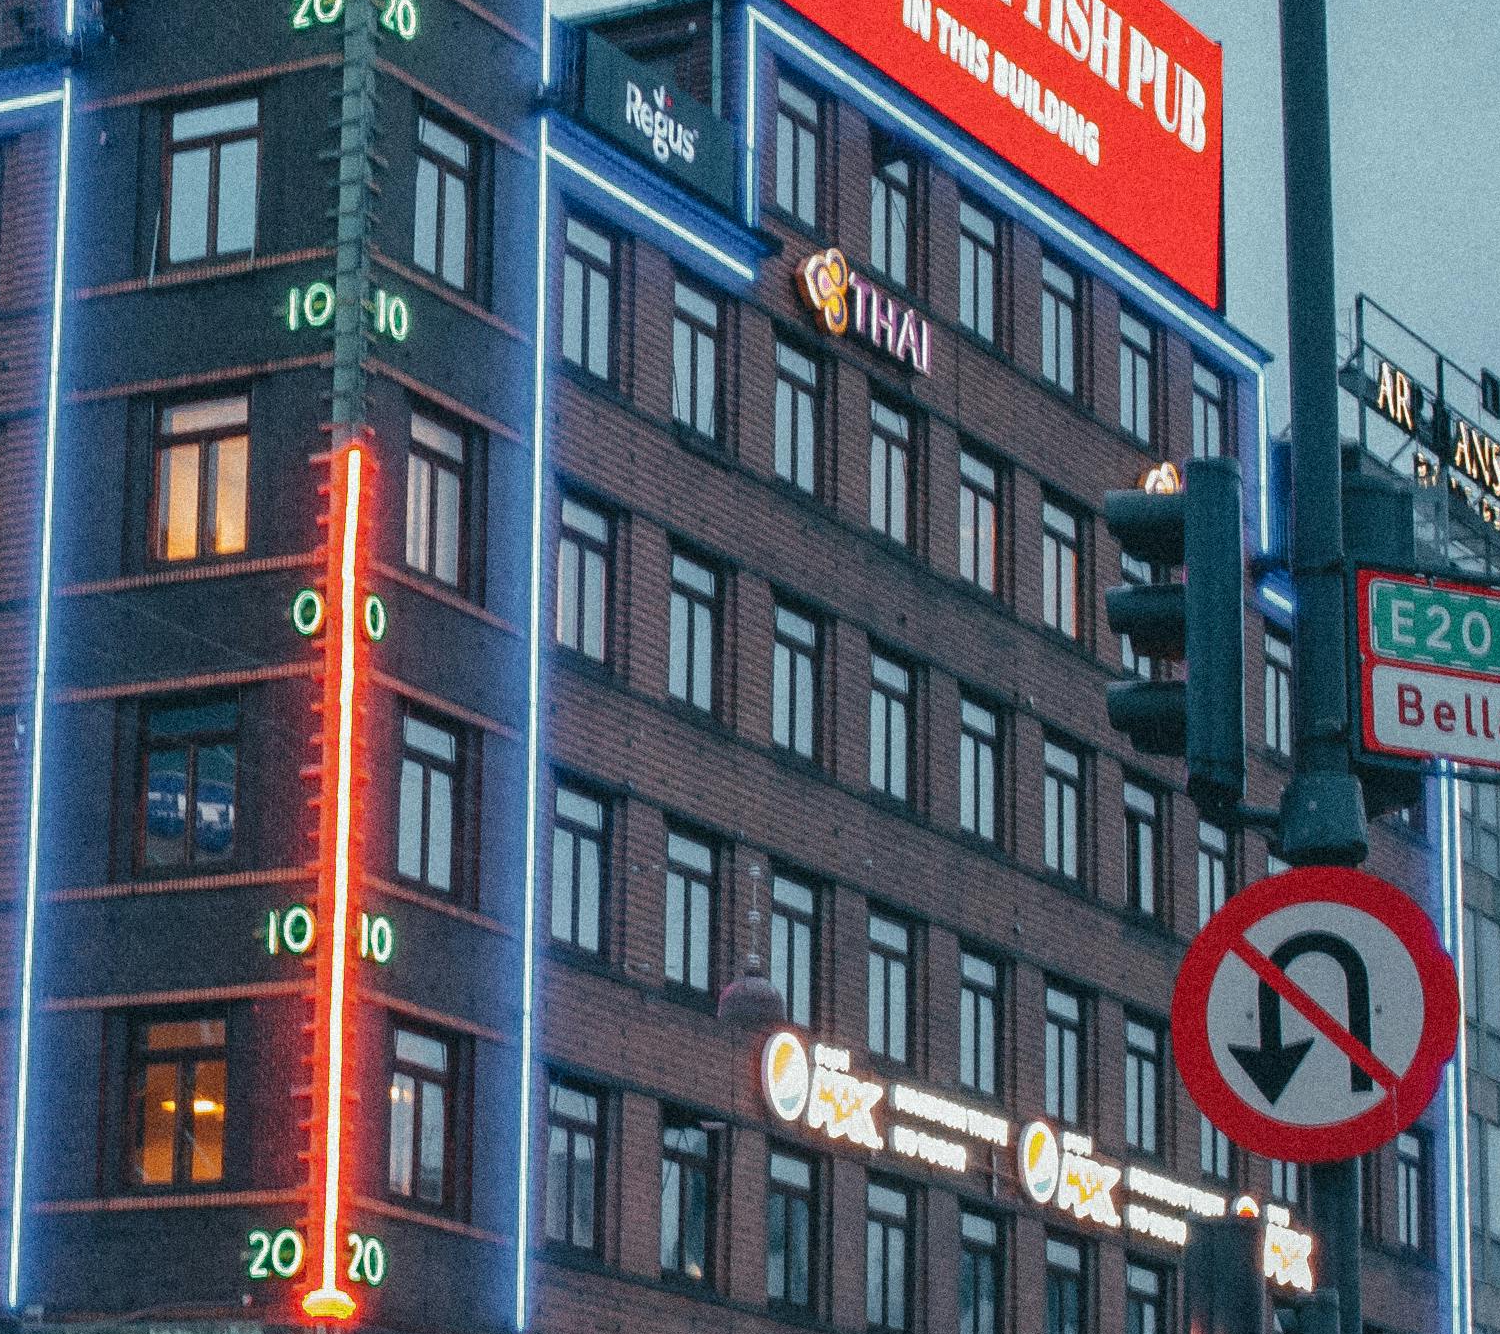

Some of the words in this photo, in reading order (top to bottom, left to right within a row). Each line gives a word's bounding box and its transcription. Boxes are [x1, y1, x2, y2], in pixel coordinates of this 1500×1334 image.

[937, 9, 988, 82] THIS
[993, 50, 1099, 166] BUILDING
[1128, 26, 1206, 152] PUB
[626, 80, 697, 164] Regus
[288, 282, 334, 330] 10
[376, 289, 408, 340] 10
[849, 272, 932, 375] THAI
[292, 590, 324, 635] 0
[364, 593, 386, 640] 0
[1391, 598, 1492, 657] E20
[267, 906, 315, 955] 10
[360, 912, 394, 964] 10
[249, 1230, 305, 1278] 20
[348, 1233, 386, 1286] 20
